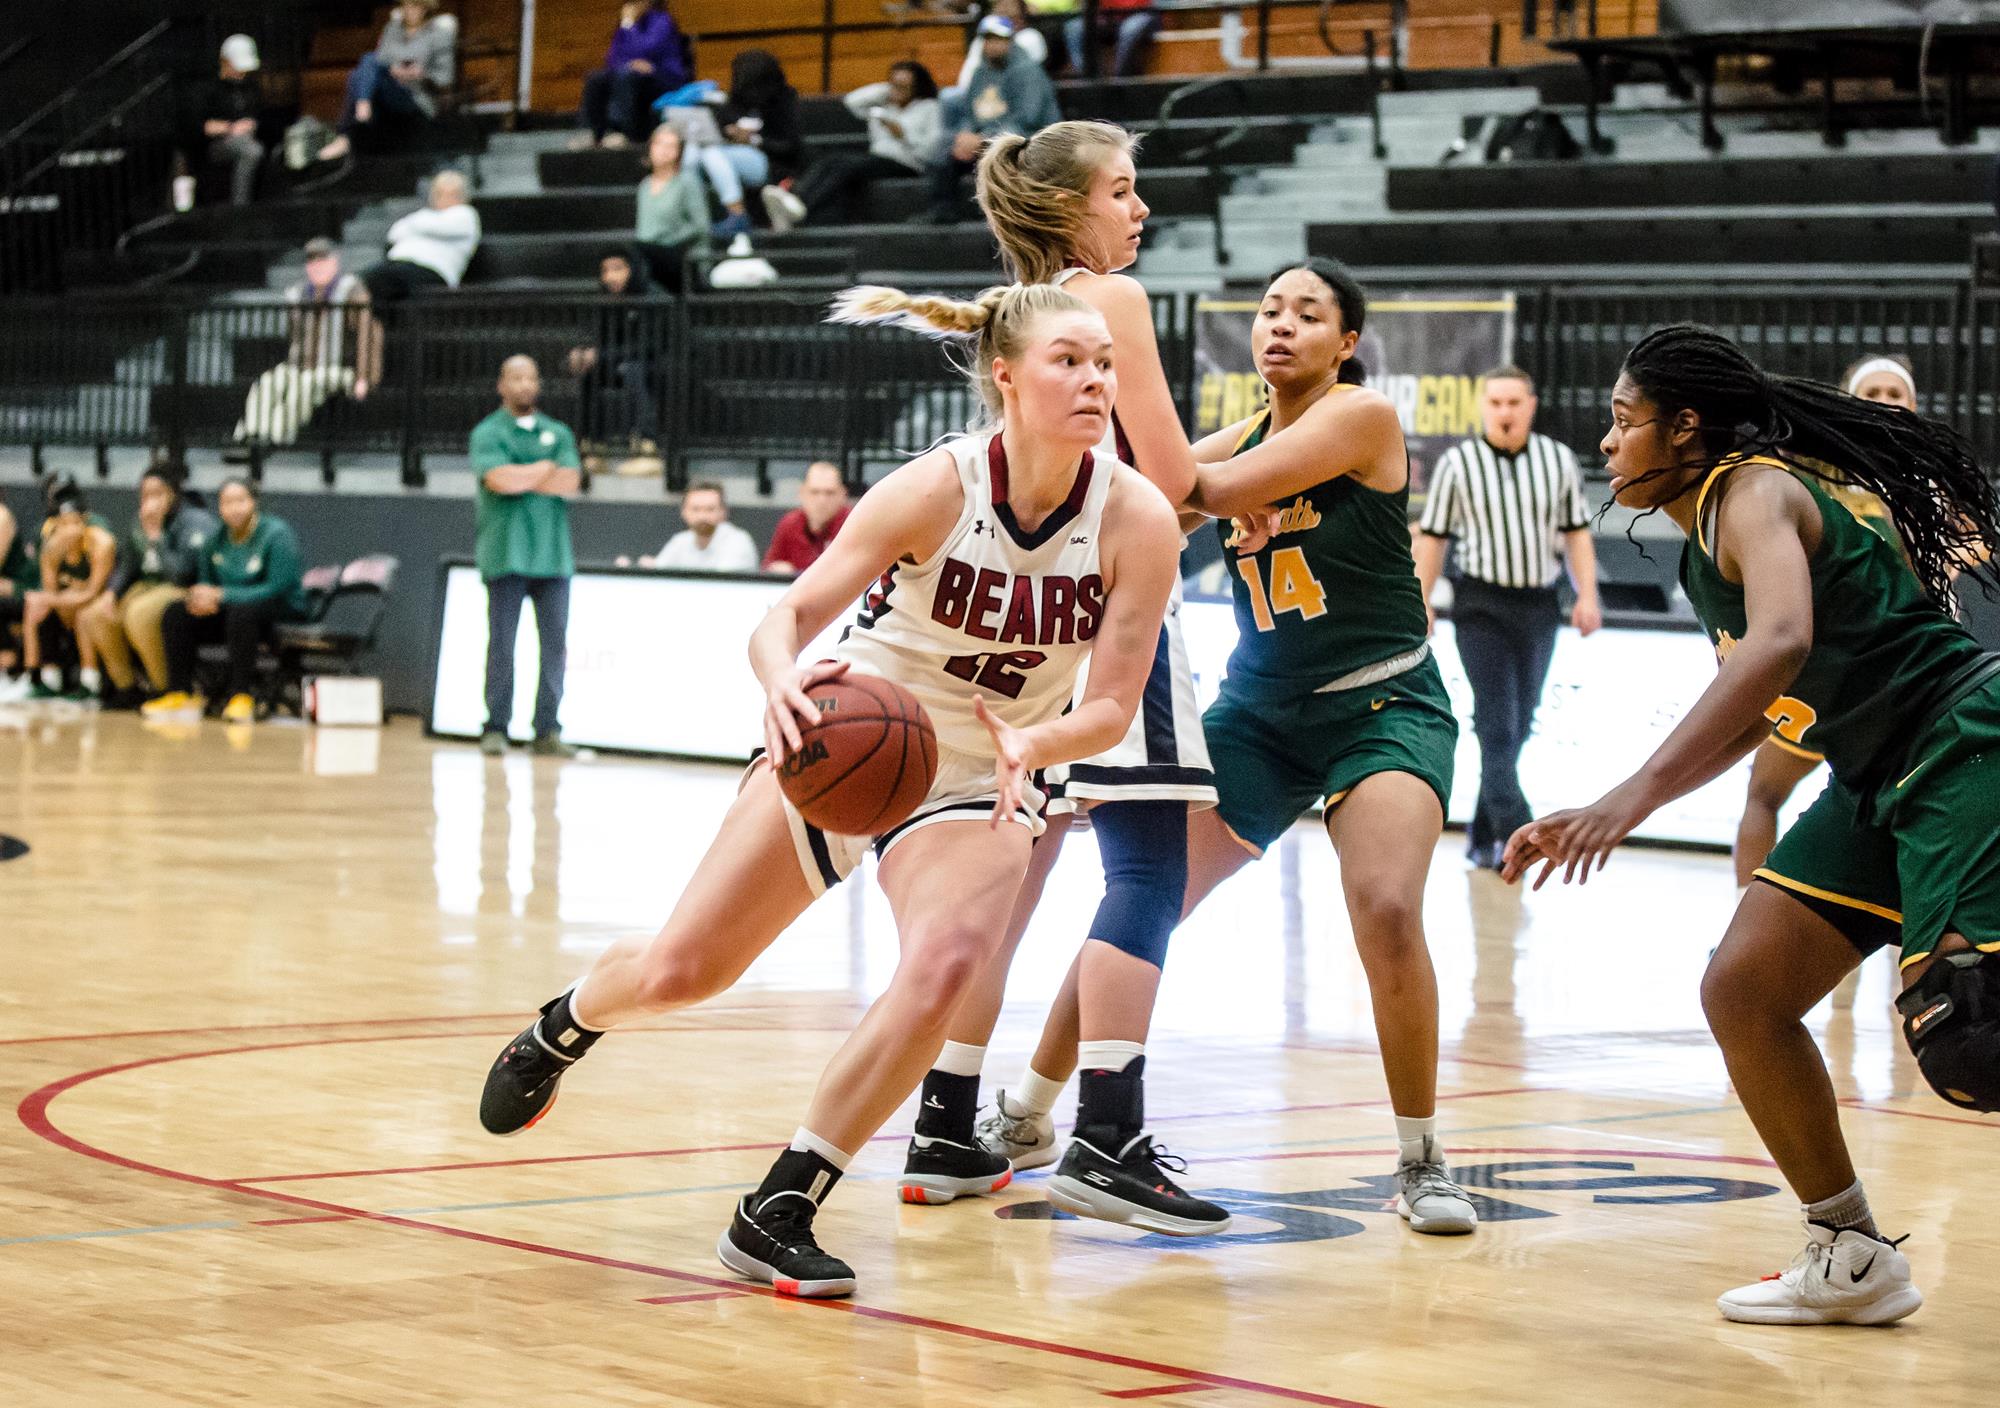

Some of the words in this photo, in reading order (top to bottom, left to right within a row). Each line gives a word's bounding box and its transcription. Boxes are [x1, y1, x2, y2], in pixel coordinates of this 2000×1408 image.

[1070, 536, 1089, 545] SAC
[931, 556, 1104, 646] BEARS
[1236, 545, 1328, 632] 14
[783, 738, 830, 777] CAA
